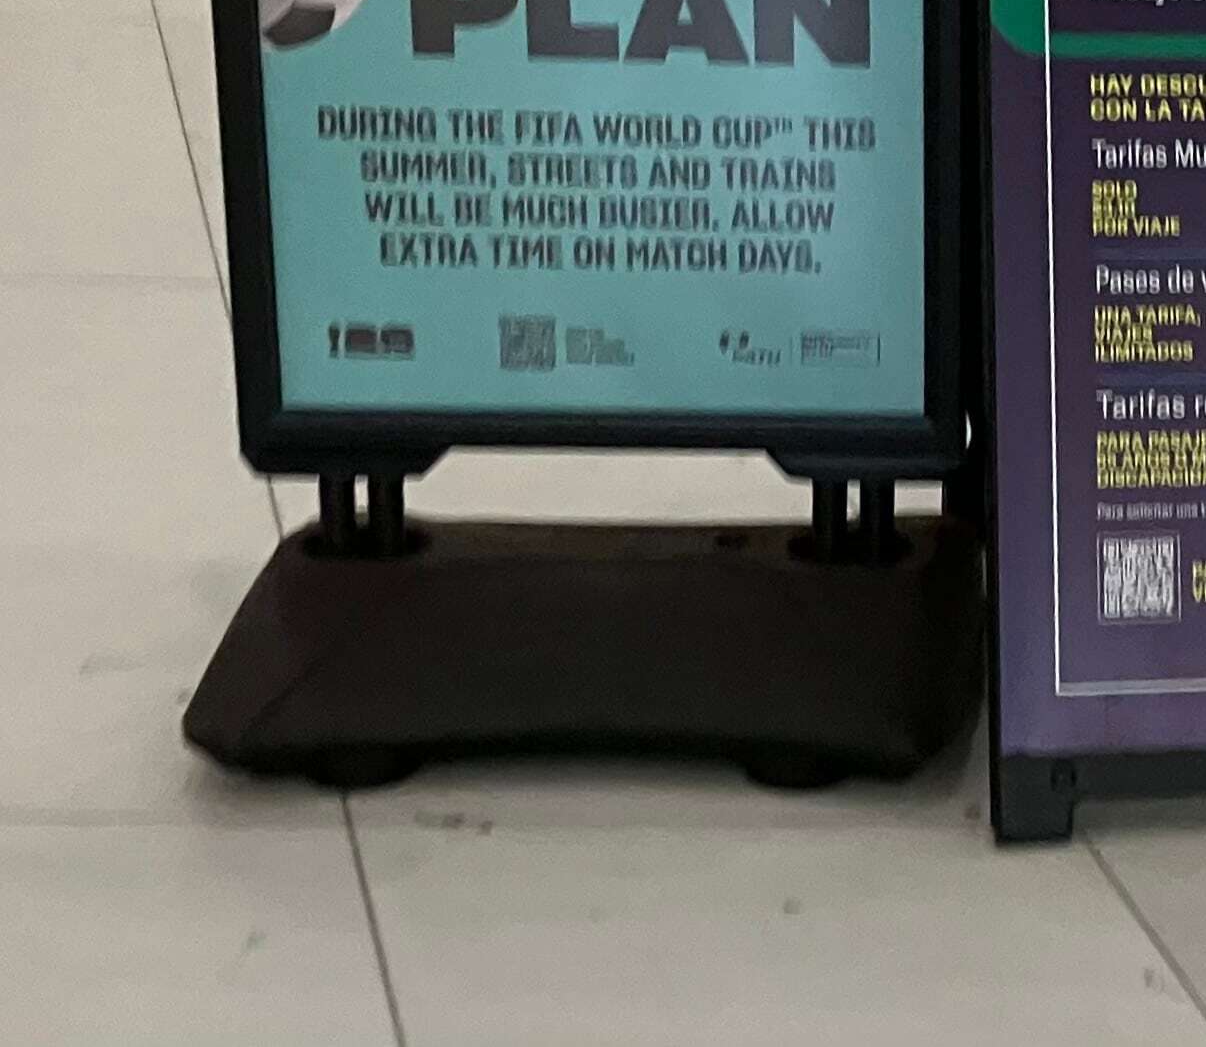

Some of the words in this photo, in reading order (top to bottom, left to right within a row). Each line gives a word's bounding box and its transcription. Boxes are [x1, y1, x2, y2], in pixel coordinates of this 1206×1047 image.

[1090, 73, 1133, 95] HAY
[1090, 98, 1137, 122] CON
[1145, 99, 1172, 122] LA
[317, 105, 437, 142] DURING
[448, 108, 504, 144] THE
[515, 110, 583, 146] FIFA
[593, 112, 701, 150] WORLD
[803, 116, 876, 152] THIS
[1092, 137, 1167, 169] Tarifas
[361, 149, 496, 189] SUMMER,
[508, 152, 638, 190] STREETS
[649, 154, 711, 190] AND
[721, 156, 836, 192] TRAINS
[364, 190, 444, 227] WILL
[454, 192, 492, 227] BE
[502, 193, 588, 229] MUCH
[731, 197, 835, 233] ALLOW
[1092, 216, 1129, 237] POR
[1133, 215, 1181, 237] VIAJE
[380, 230, 478, 267] EXTRA
[488, 232, 563, 270] TIME
[572, 234, 615, 271] ON
[626, 236, 727, 272] MATCH
[738, 238, 822, 274] DAYS.
[1095, 263, 1160, 295] Pases
[1167, 263, 1194, 294] de
[1095, 305, 1131, 328] UNA
[1095, 340, 1194, 363] ILIMITADOS
[1096, 389, 1185, 420] Tarifas
[1097, 430, 1143, 452] PARA
